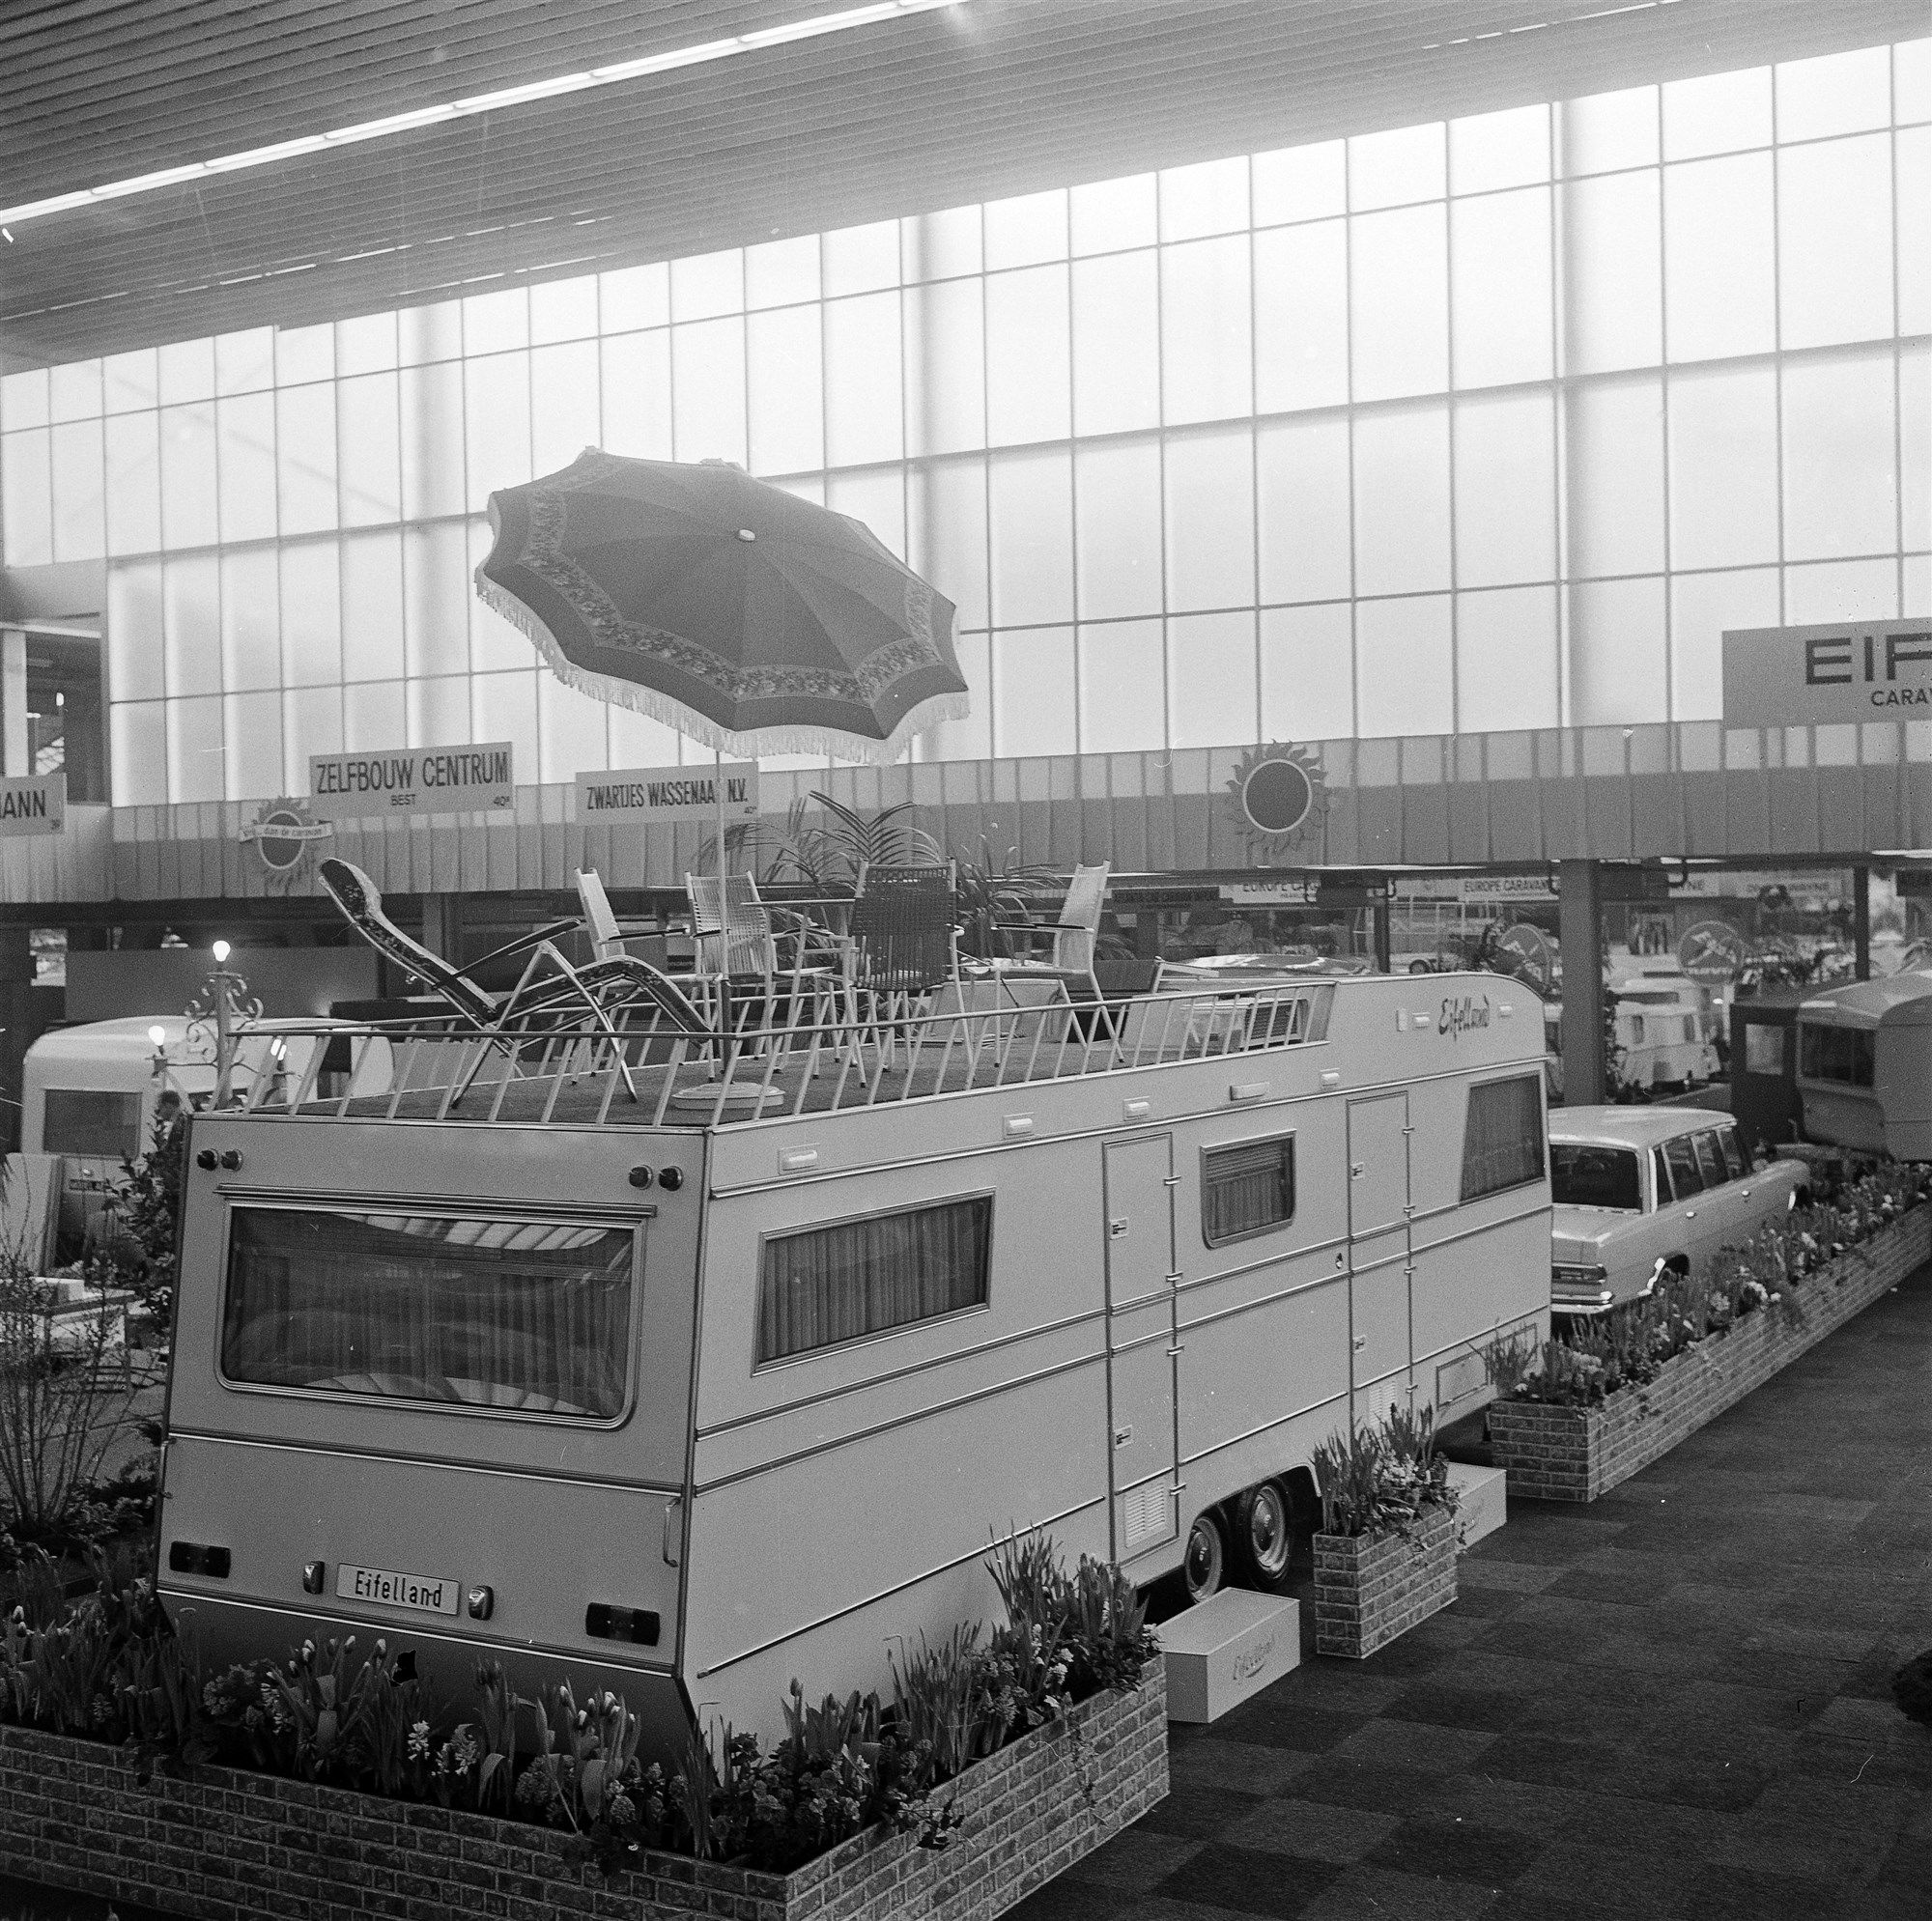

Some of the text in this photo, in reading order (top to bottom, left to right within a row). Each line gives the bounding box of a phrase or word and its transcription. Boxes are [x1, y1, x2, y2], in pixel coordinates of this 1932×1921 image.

[1804, 633, 1932, 686] EIF
[1870, 687, 1932, 707] CARA
[316, 751, 508, 795] ZELFBOUW CENTRUM
[0, 789, 46, 819] ANN
[390, 794, 417, 806] BEST
[585, 783, 645, 810] ZWARTJES
[646, 778, 726, 807] WASSENAA
[1463, 881, 1501, 892] EUROPE
[1438, 995, 1491, 1042] Eifelland
[355, 1569, 443, 1608] Eifelland
